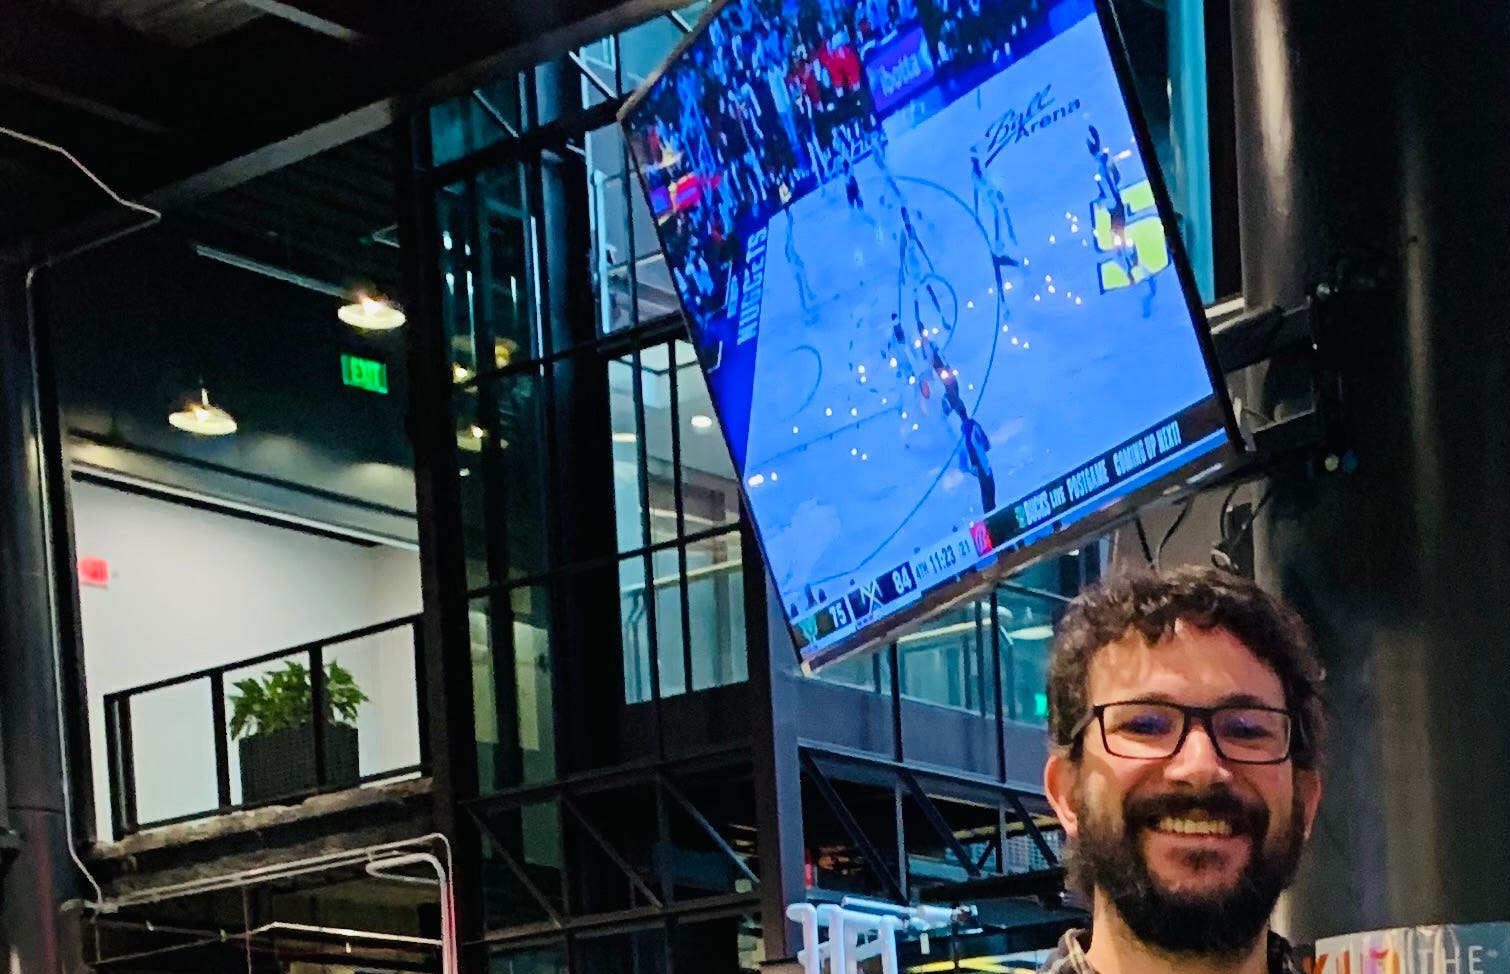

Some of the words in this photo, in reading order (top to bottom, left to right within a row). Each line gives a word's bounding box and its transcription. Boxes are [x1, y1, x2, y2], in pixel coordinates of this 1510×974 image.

[929, 549, 957, 576] 11:23
[892, 568, 914, 595] 84
[830, 601, 848, 629] 75
